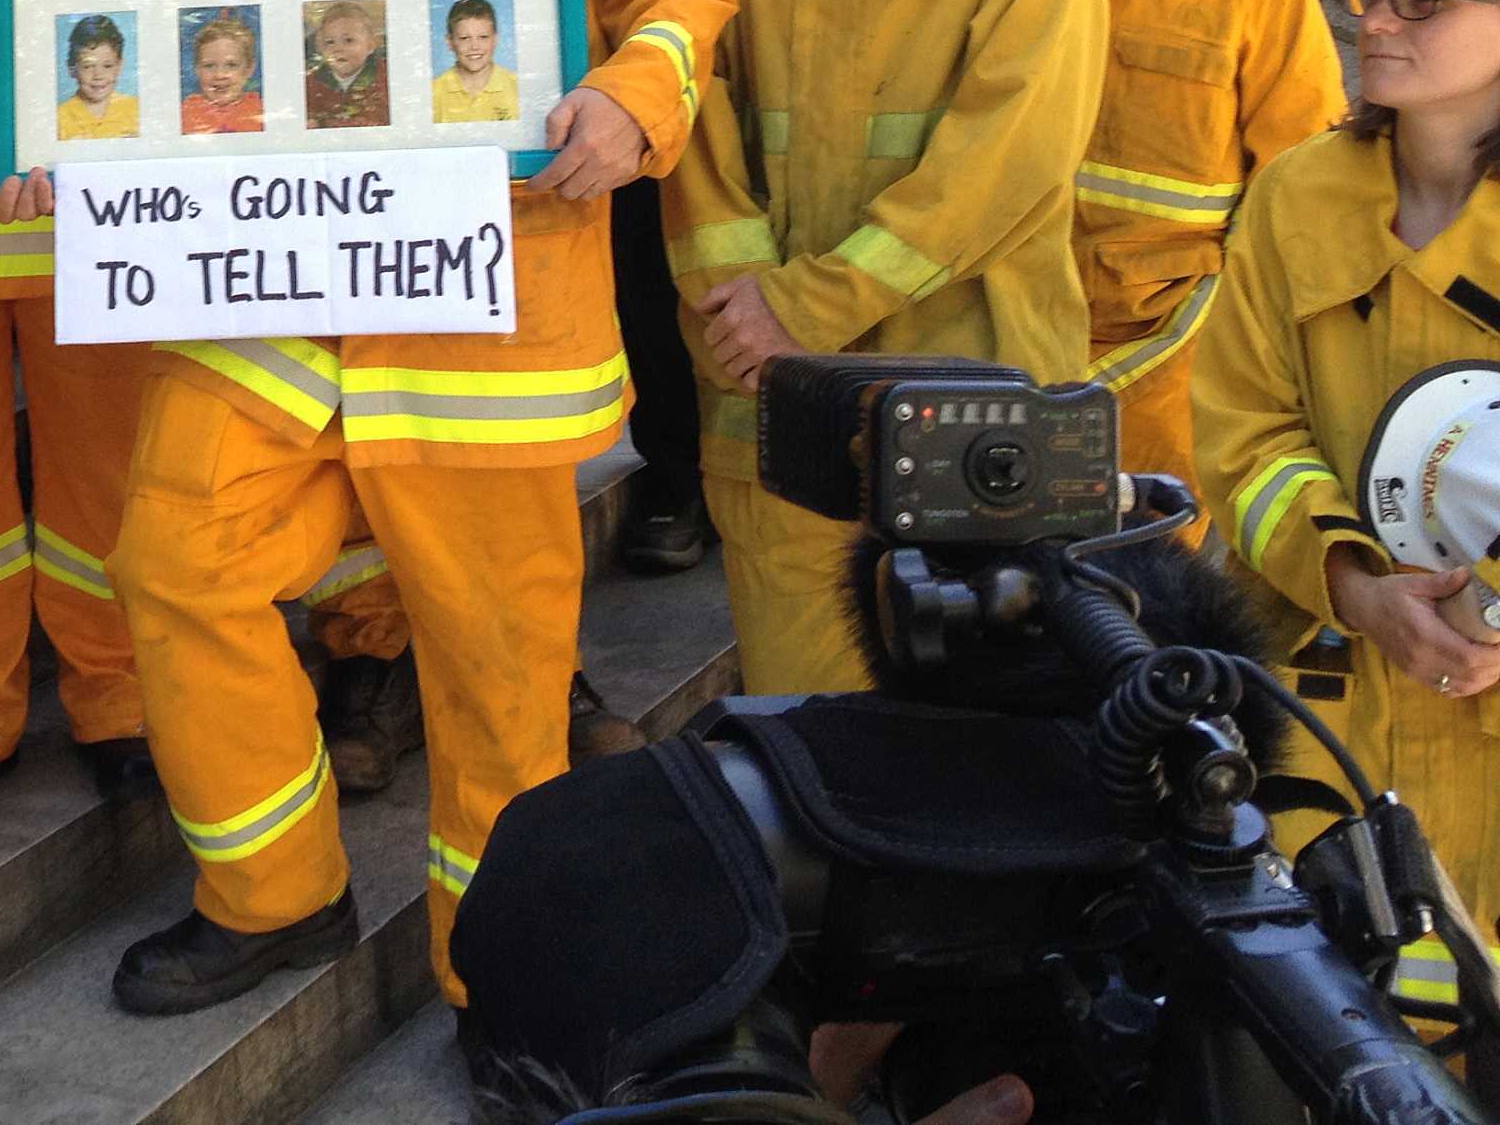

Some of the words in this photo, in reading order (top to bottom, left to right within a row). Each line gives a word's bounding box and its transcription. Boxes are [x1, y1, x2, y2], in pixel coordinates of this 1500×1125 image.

[230, 170, 395, 221] GOING
[96, 261, 155, 310] TO
[187, 248, 325, 305] TELL
[338, 222, 506, 317] THEM?
